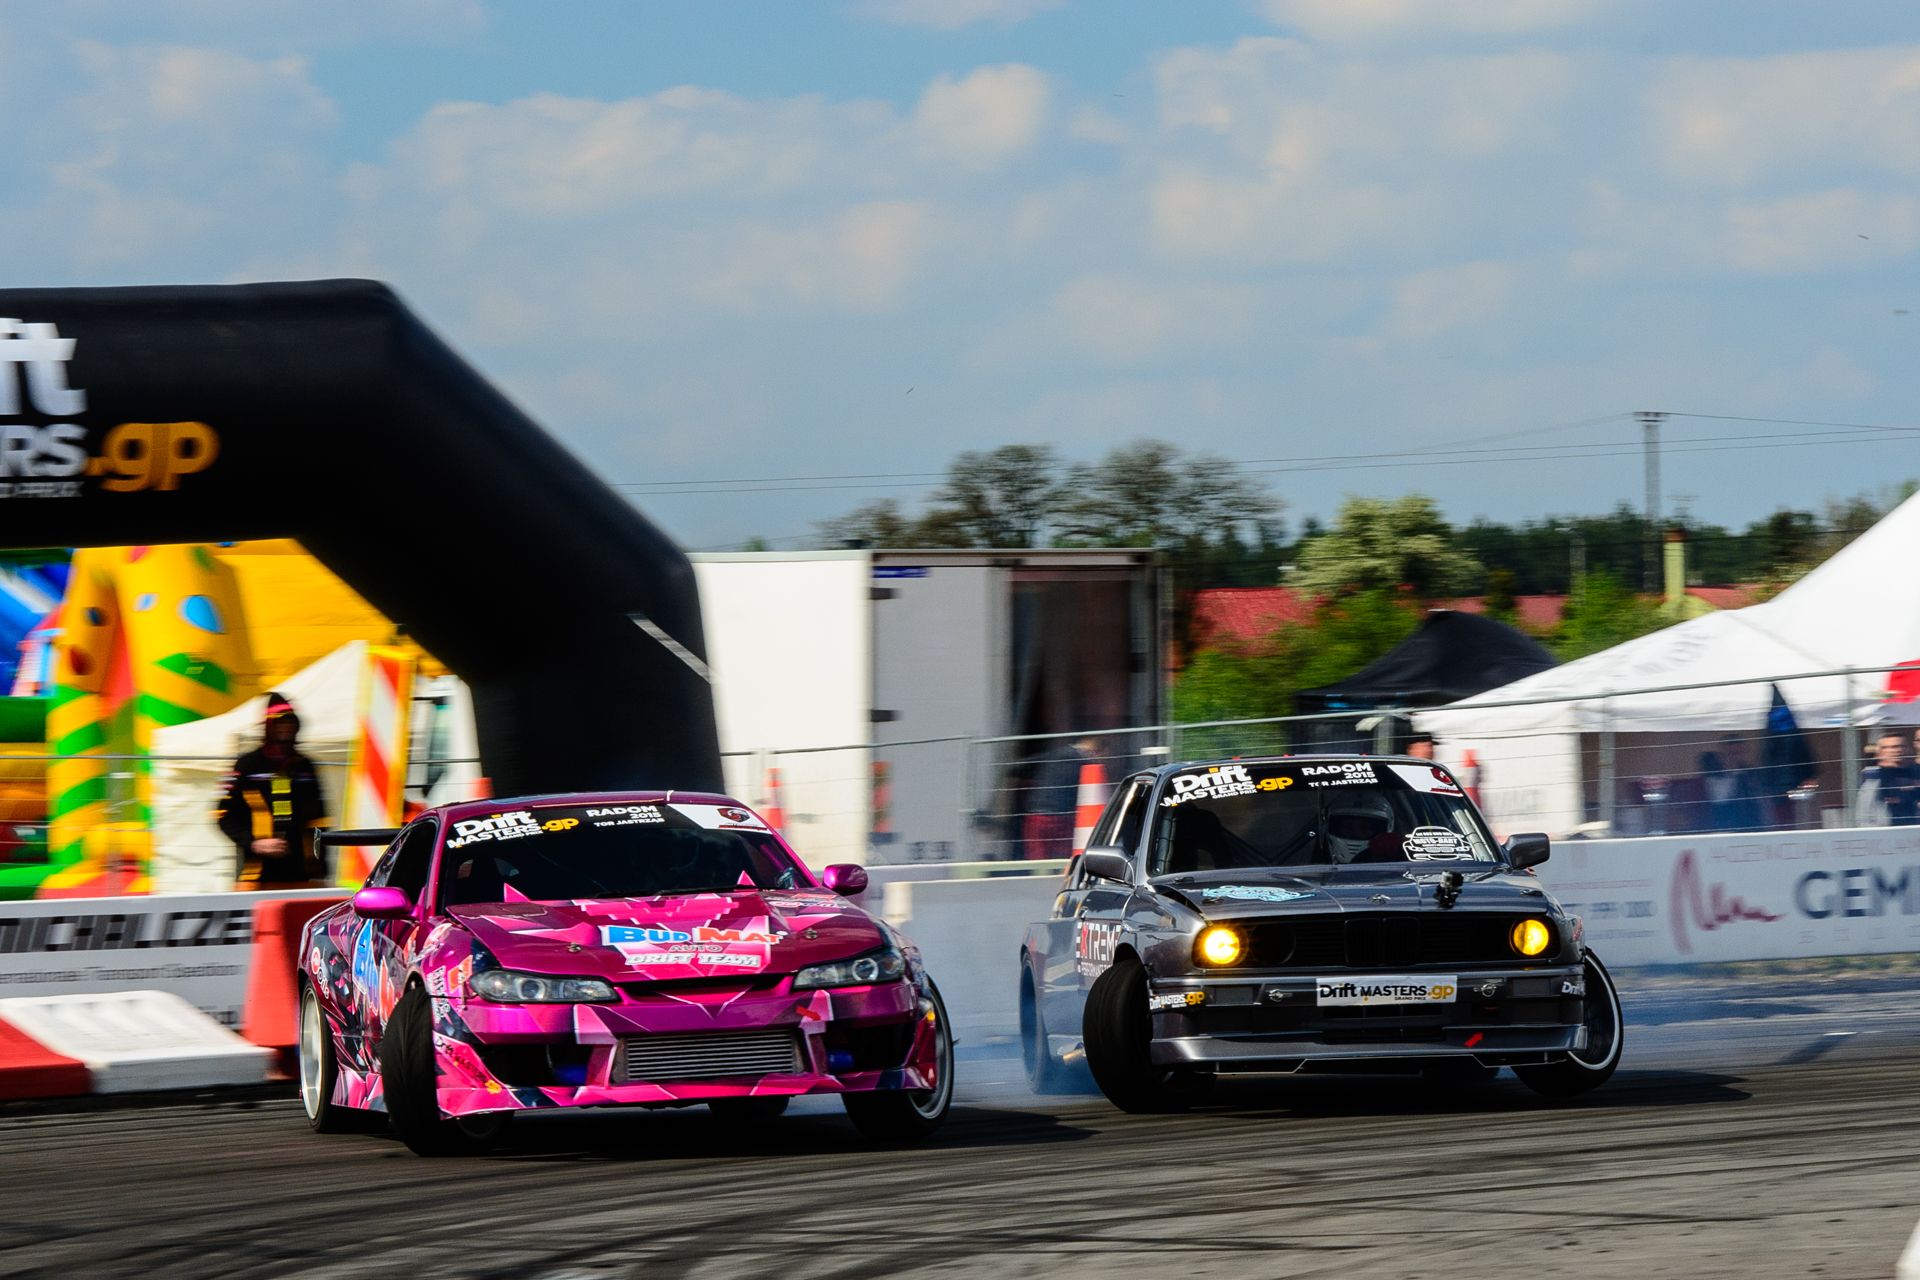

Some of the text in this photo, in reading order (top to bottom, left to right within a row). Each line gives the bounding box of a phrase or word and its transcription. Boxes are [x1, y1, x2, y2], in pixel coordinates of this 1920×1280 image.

[1301, 762, 1372, 776] RADOM
[1344, 771, 1376, 779] 2015
[1172, 765, 1252, 794] Drift
[586, 805, 658, 818] RADOM
[453, 811, 537, 837] Drift
[607, 926, 781, 944] BUD MAT
[669, 944, 723, 952] AUTO
[626, 953, 762, 967] DRIFT TEAM
[1319, 983, 1358, 998] Drift
